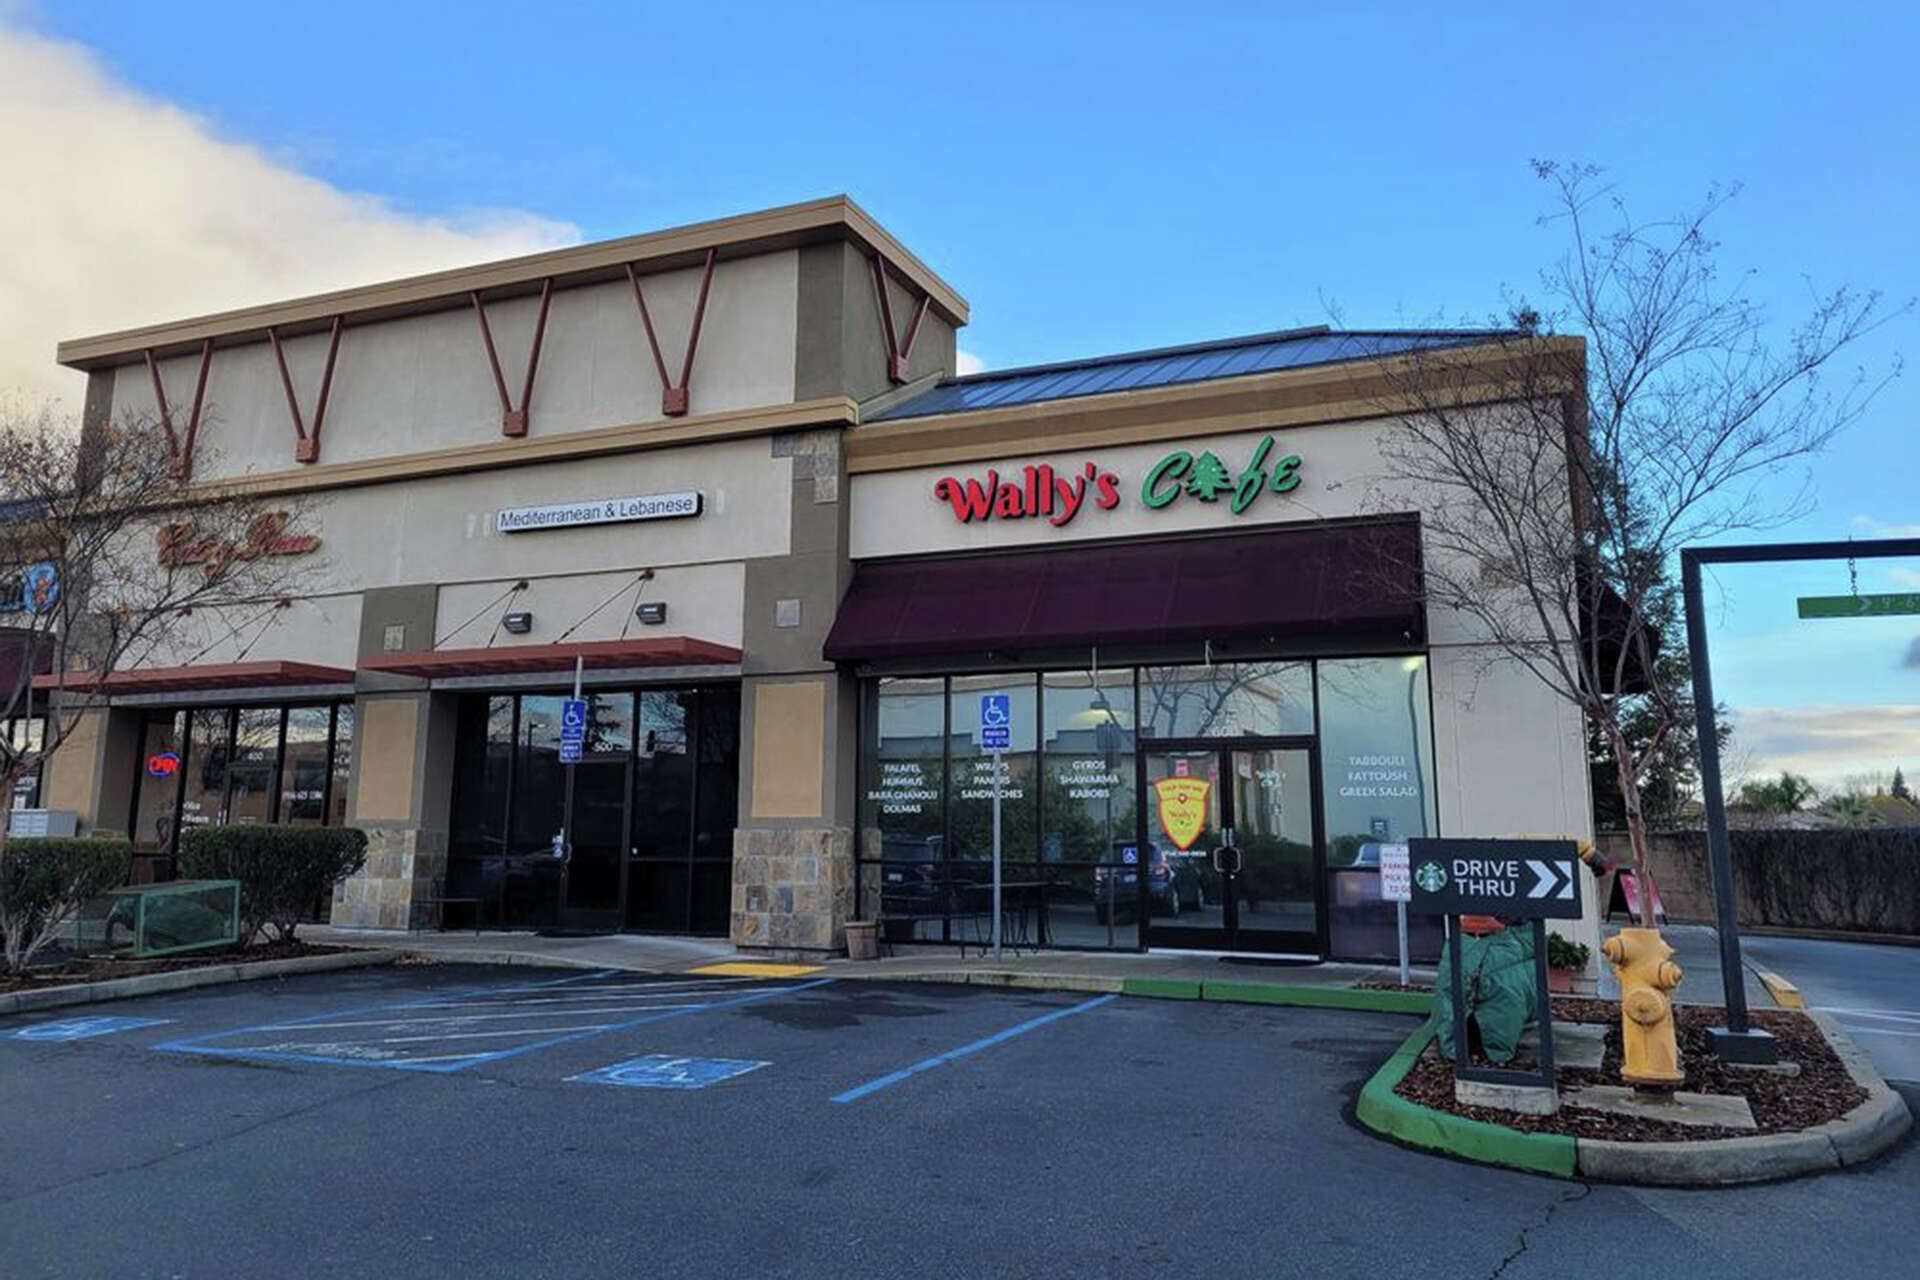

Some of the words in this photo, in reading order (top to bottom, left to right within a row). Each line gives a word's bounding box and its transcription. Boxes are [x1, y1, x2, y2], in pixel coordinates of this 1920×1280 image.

[935, 461, 1120, 526] Wally's
[500, 505, 600, 528] Mediterranean
[605, 502, 615, 518] &
[620, 498, 693, 518] Lebanese
[884, 763, 922, 773] FALAFEL
[975, 762, 1009, 772] WRAS
[961, 789, 1023, 799] SANDWCHES
[1340, 787, 1377, 797] GREEK
[1379, 787, 1417, 797] SALAD
[883, 804, 922, 814] DOLMAS
[1453, 859, 1519, 878] DRIVE
[1454, 879, 1516, 897] THRU
